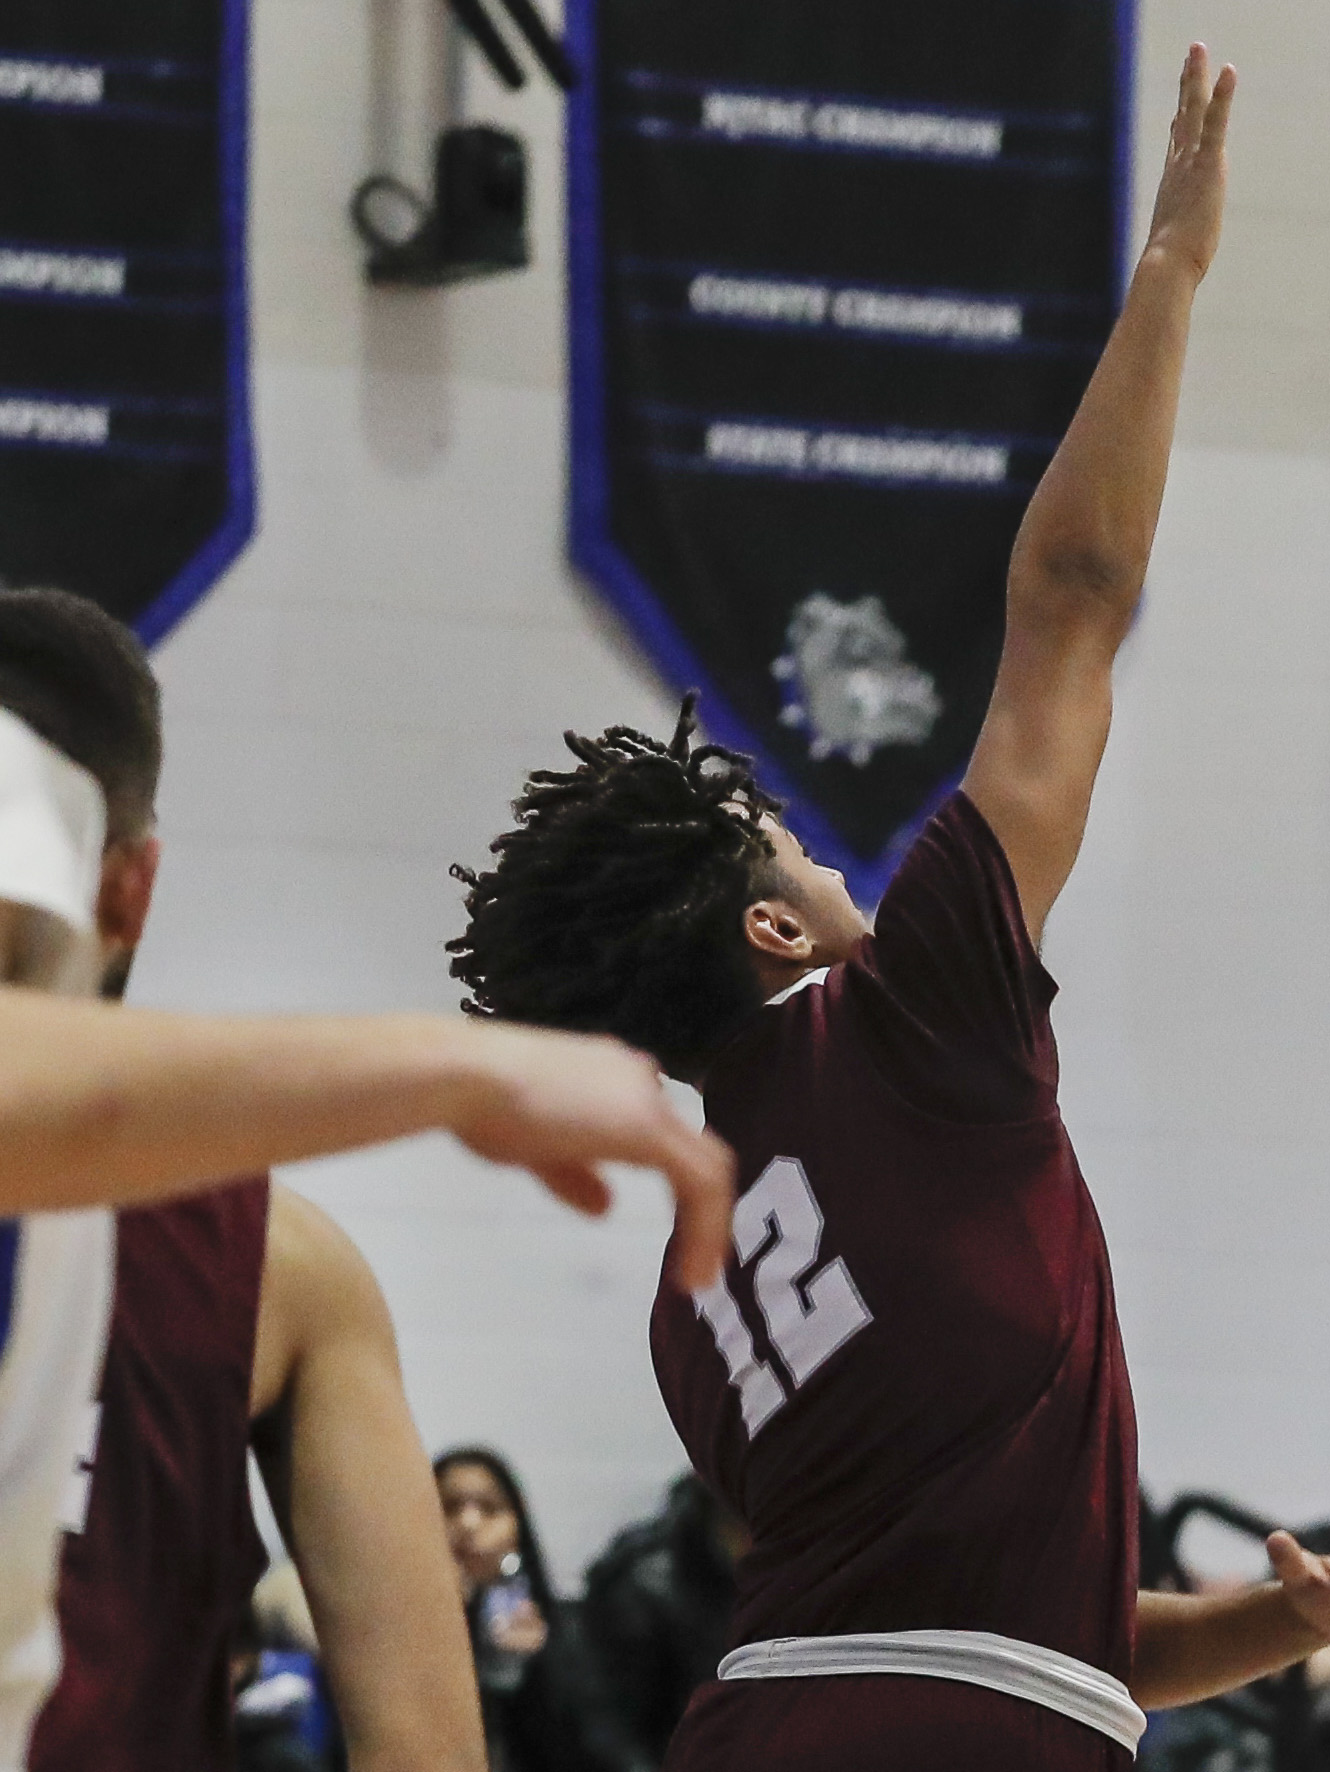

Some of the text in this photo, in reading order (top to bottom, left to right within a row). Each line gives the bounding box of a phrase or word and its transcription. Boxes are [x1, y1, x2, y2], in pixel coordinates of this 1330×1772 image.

[810, 101, 1002, 160] CHAMPION
[689, 273, 1022, 342] COUNTY CHAMPION
[704, 421, 1007, 483] STATE CHAMPION
[690, 1155, 875, 1442] 12
